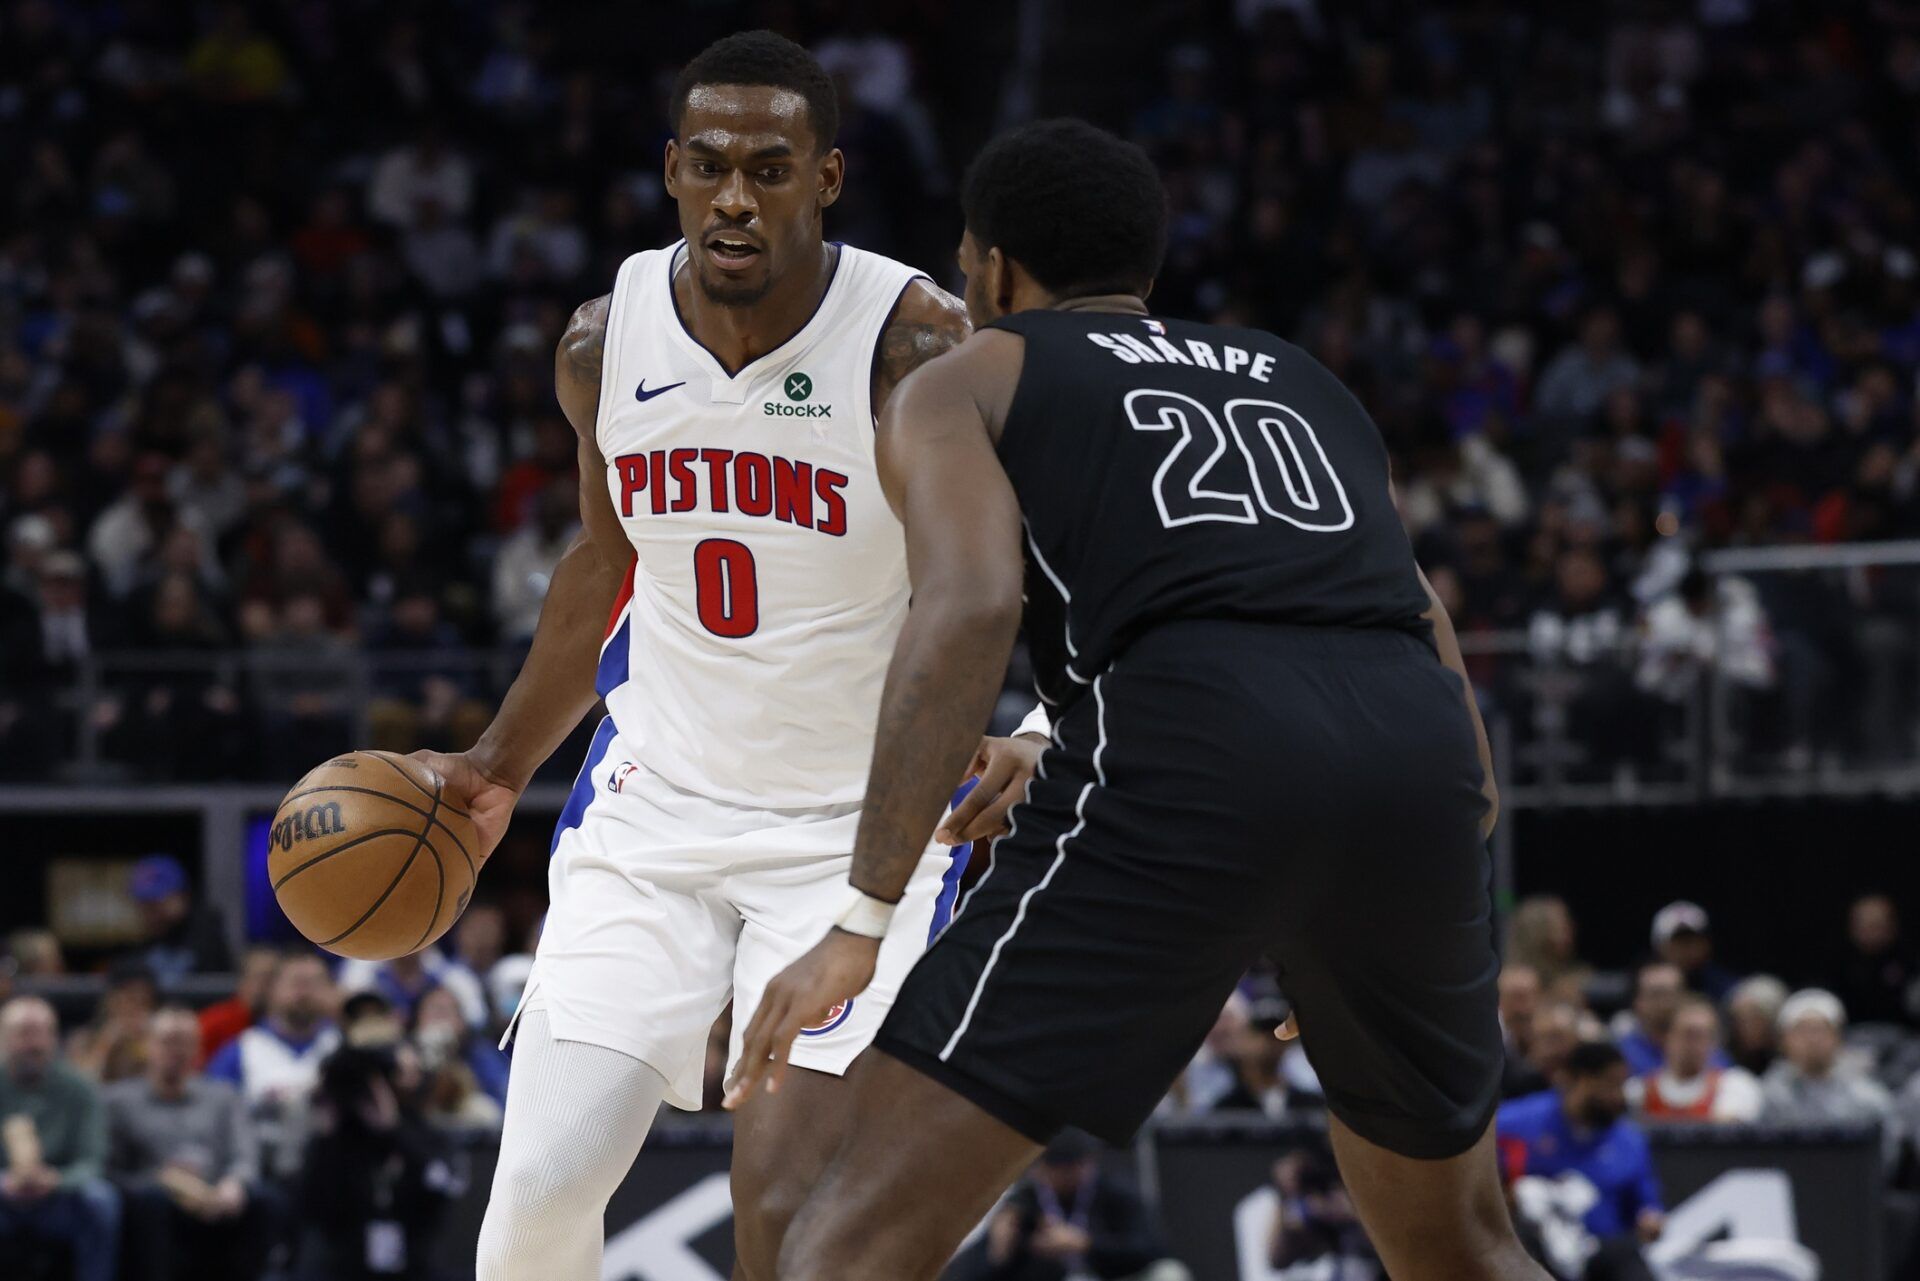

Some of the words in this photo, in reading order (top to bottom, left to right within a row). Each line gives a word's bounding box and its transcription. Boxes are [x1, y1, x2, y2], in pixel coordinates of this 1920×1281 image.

[1087, 332, 1276, 383] SHARPE
[763, 402, 832, 418] StockX
[615, 448, 848, 537] PISTONS
[1123, 389, 1355, 532] 20
[694, 538, 759, 638] 0
